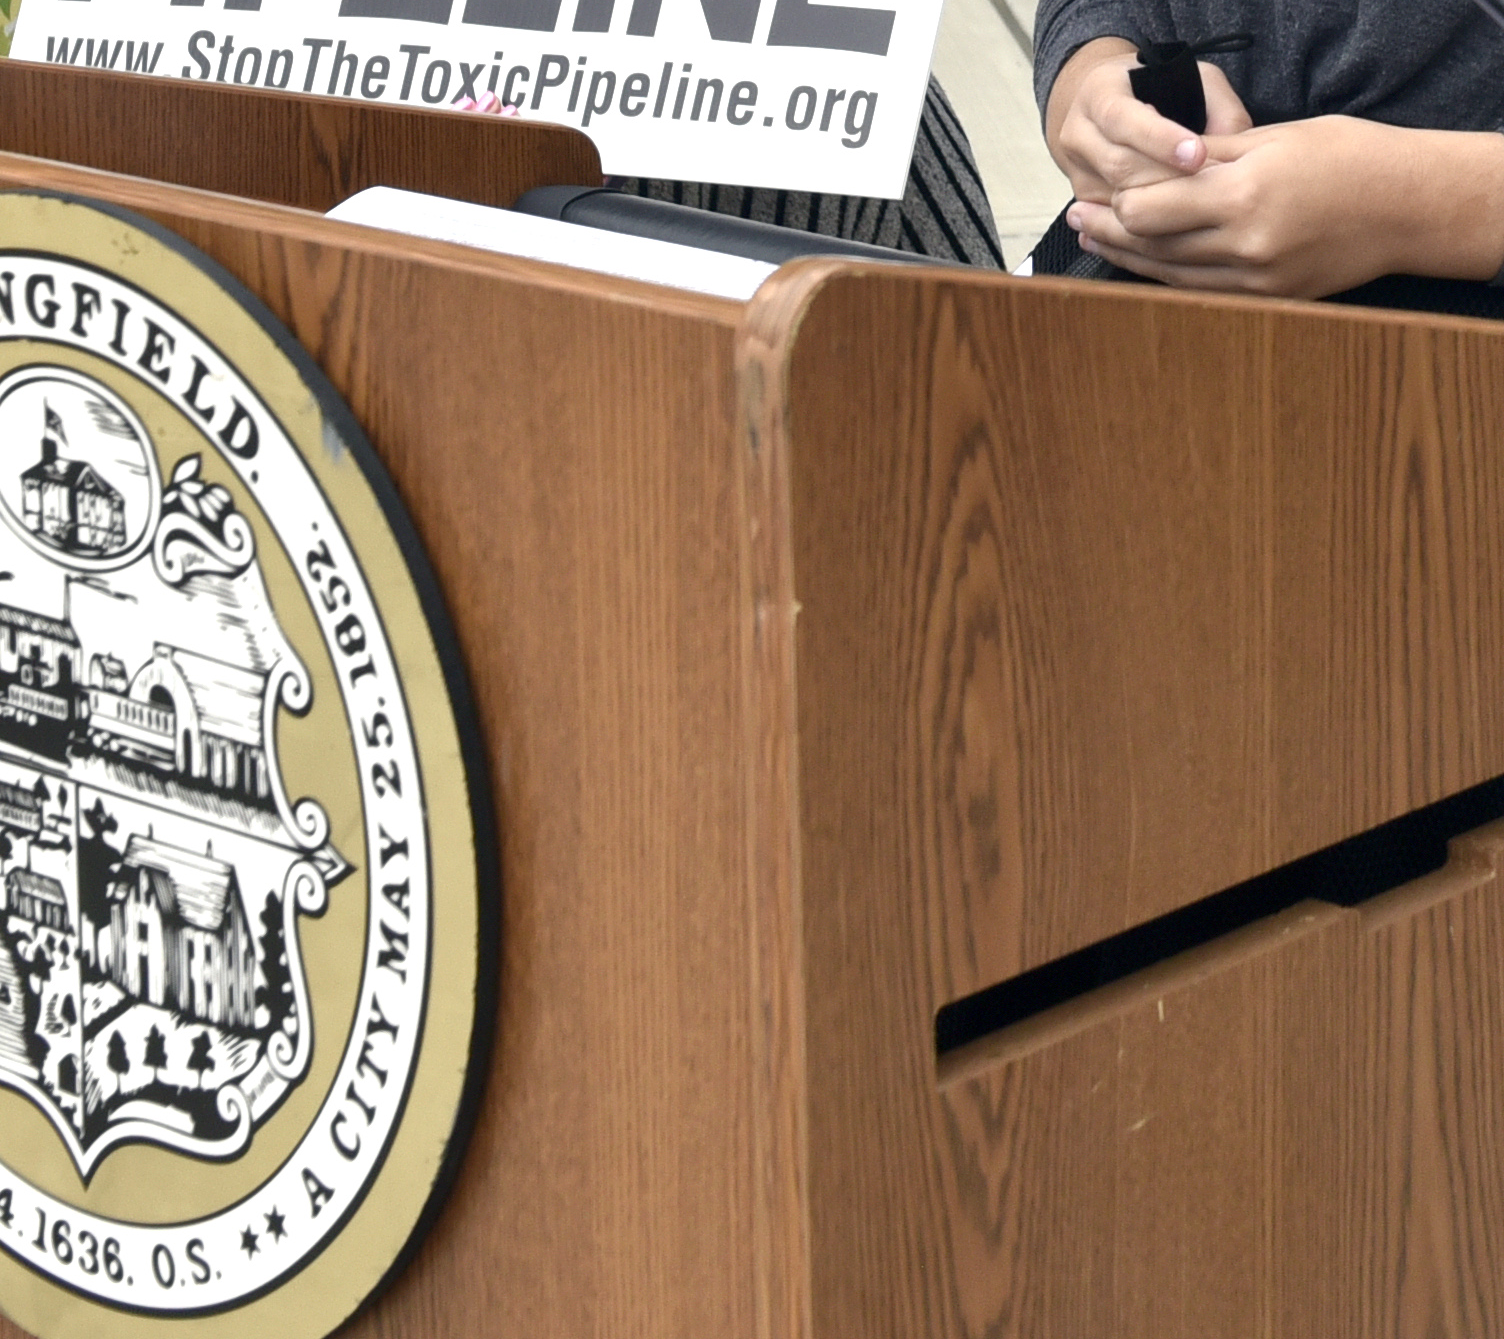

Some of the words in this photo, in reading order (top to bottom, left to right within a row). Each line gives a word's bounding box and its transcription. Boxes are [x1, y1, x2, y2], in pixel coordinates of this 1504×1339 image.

[45, 30, 878, 149] wwwStopTheToxicPipeline.org
[301, 1167, 336, 1218] A
[329, 995, 400, 1161] CITY
[376, 824, 411, 984] MAY
[152, 1238, 222, 1289] O.S.
